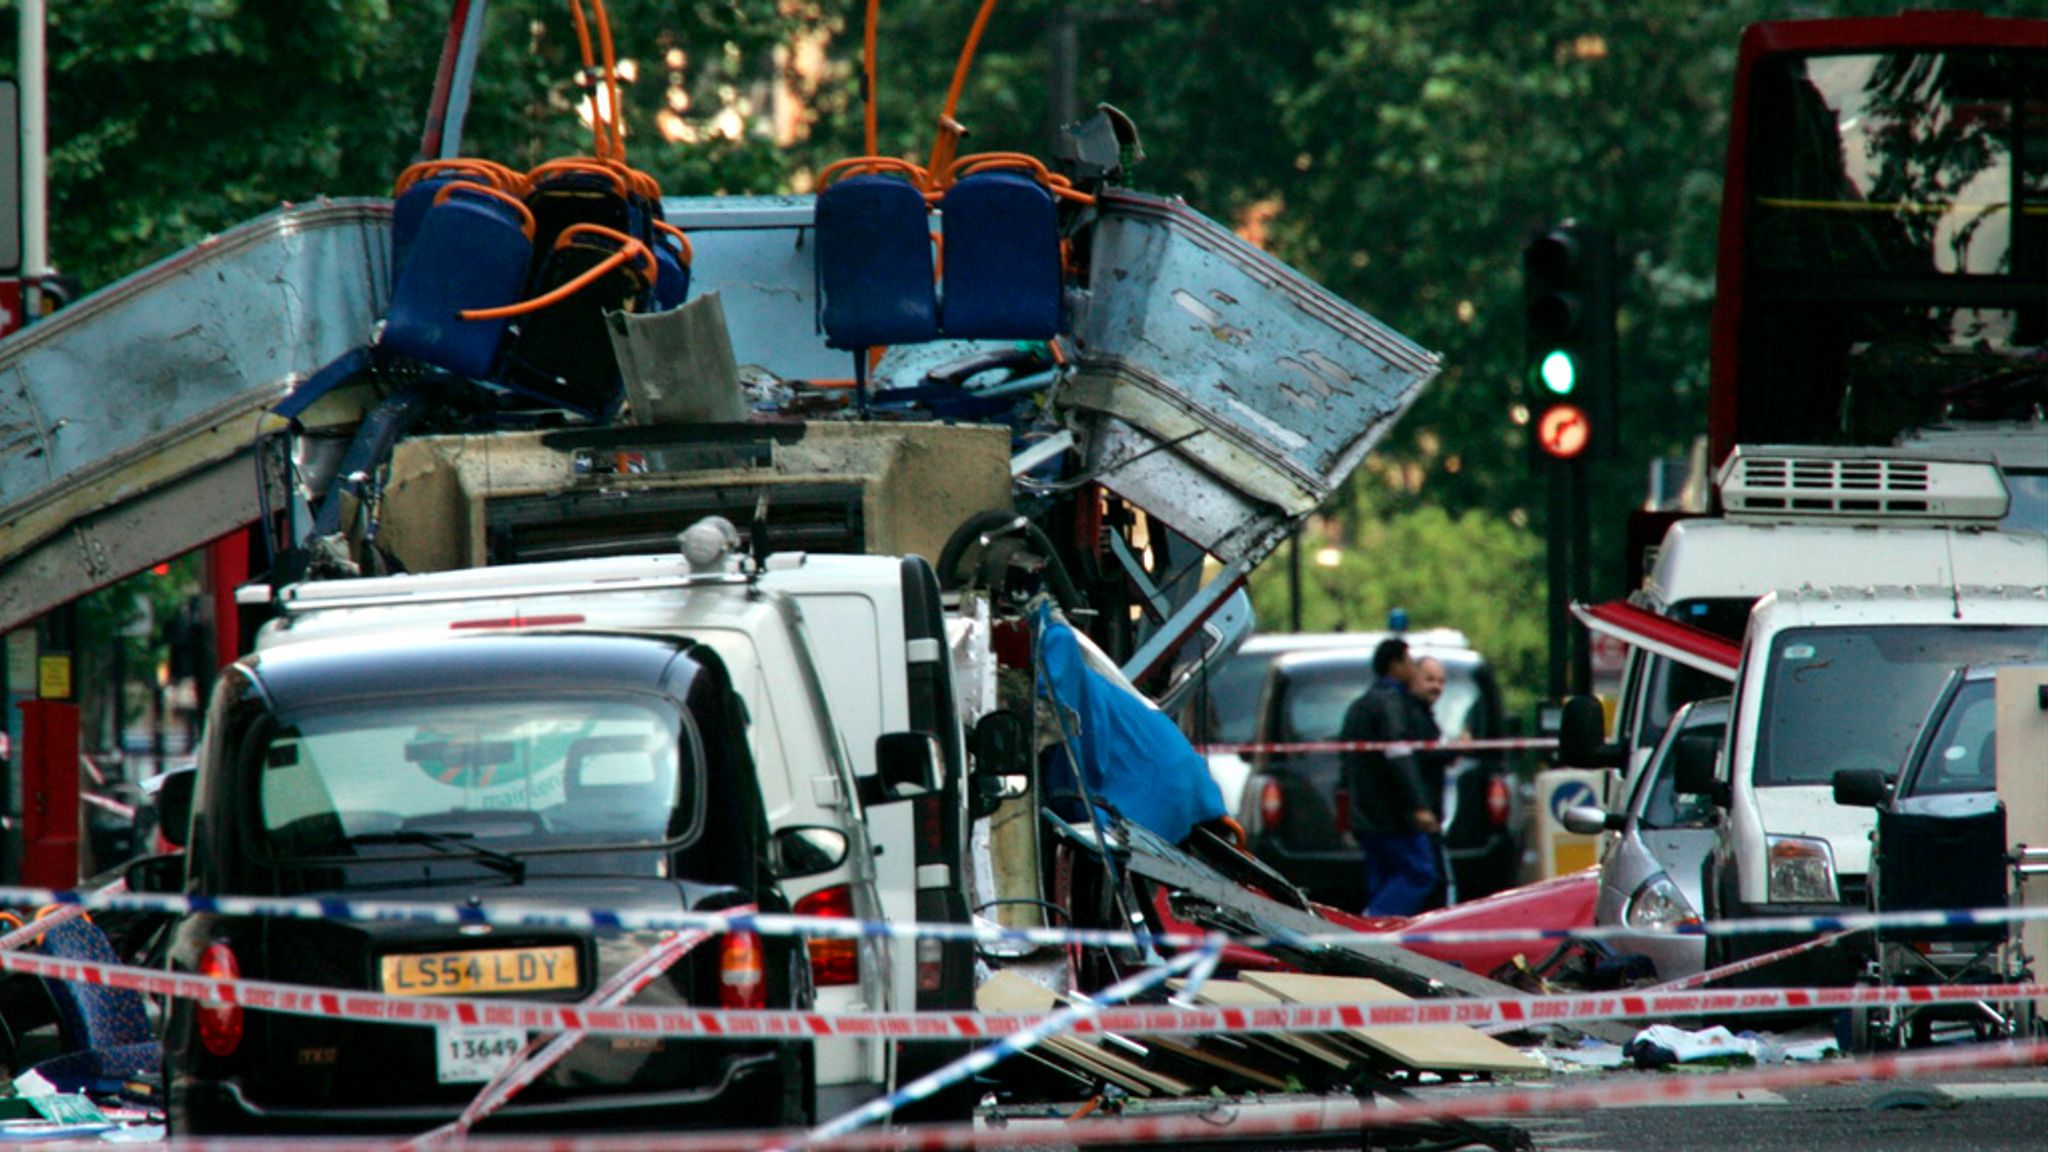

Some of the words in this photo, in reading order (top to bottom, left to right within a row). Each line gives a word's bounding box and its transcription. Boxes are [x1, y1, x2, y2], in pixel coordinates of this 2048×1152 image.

[396, 956, 482, 989] LS54
[495, 953, 559, 983] LDY
[448, 1037, 518, 1060] 13649
